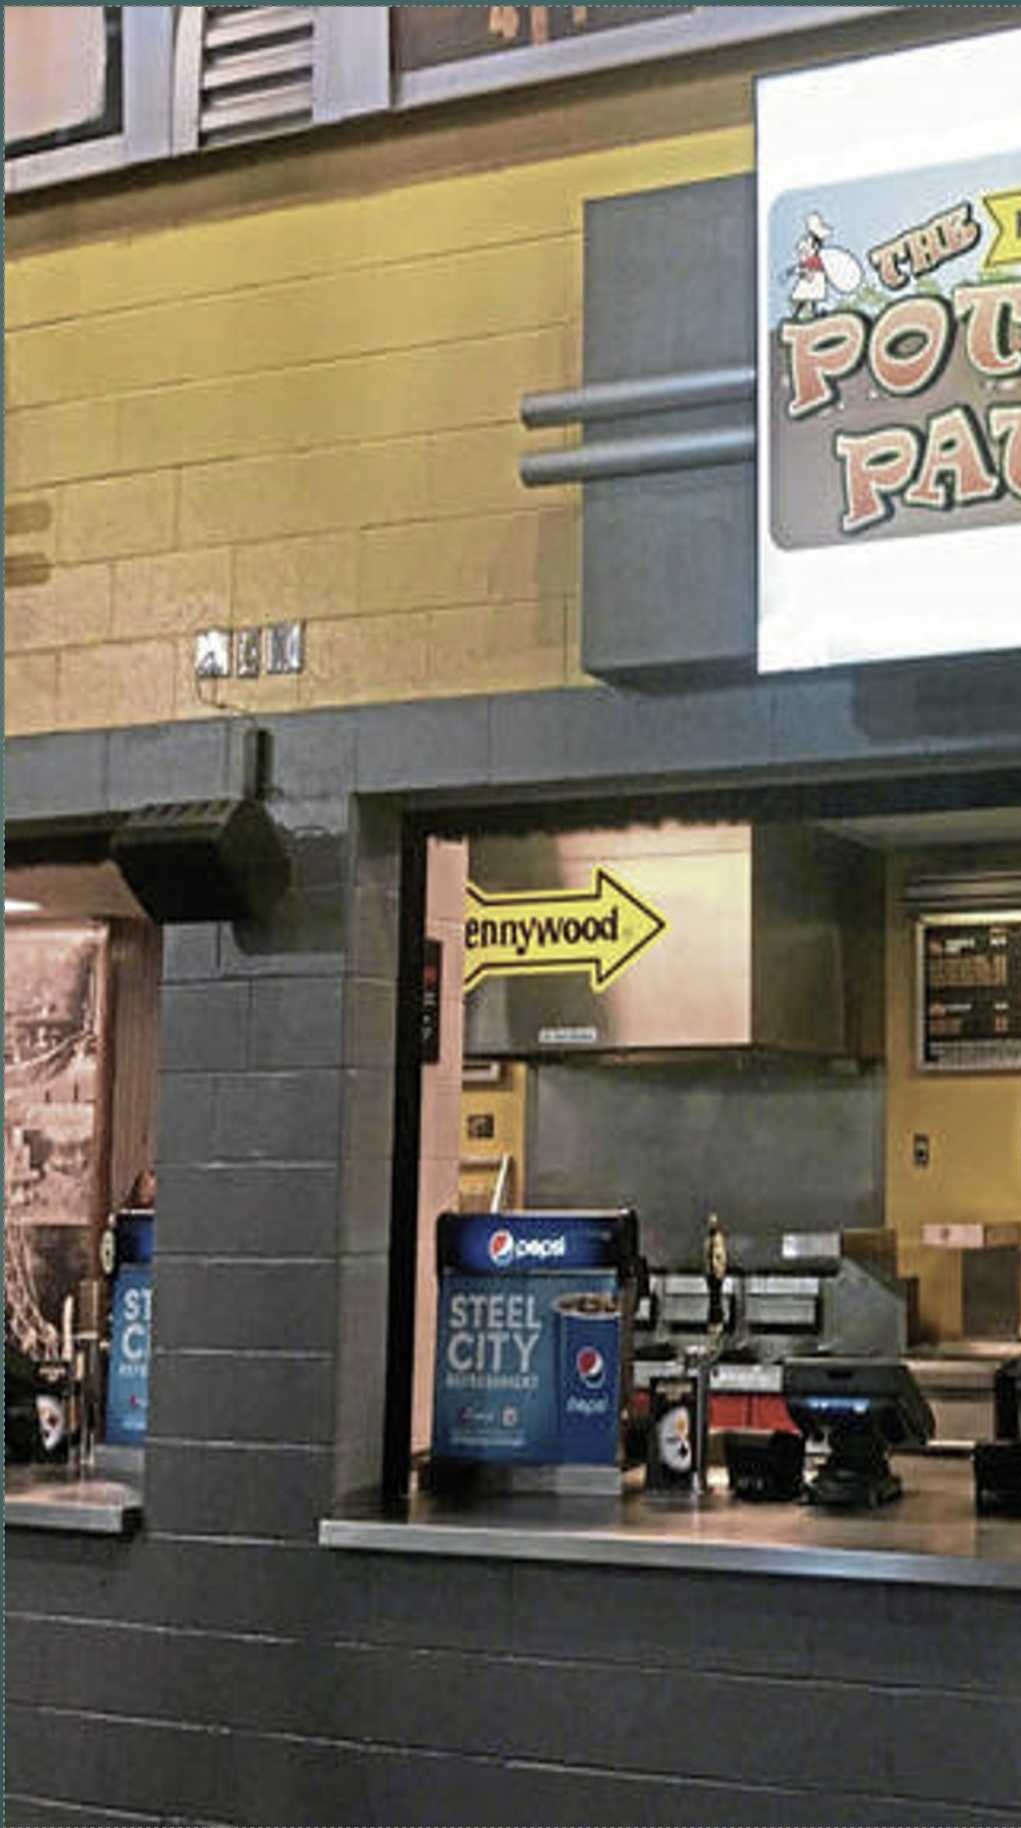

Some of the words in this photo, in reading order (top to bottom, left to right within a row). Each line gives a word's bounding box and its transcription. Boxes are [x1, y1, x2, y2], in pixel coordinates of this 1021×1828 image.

[871, 202, 980, 288] THE
[464, 905, 619, 956] ennywood
[514, 1235, 566, 1260] pepsi
[450, 1295, 542, 1329] STEEL
[447, 1331, 540, 1374] CITY
